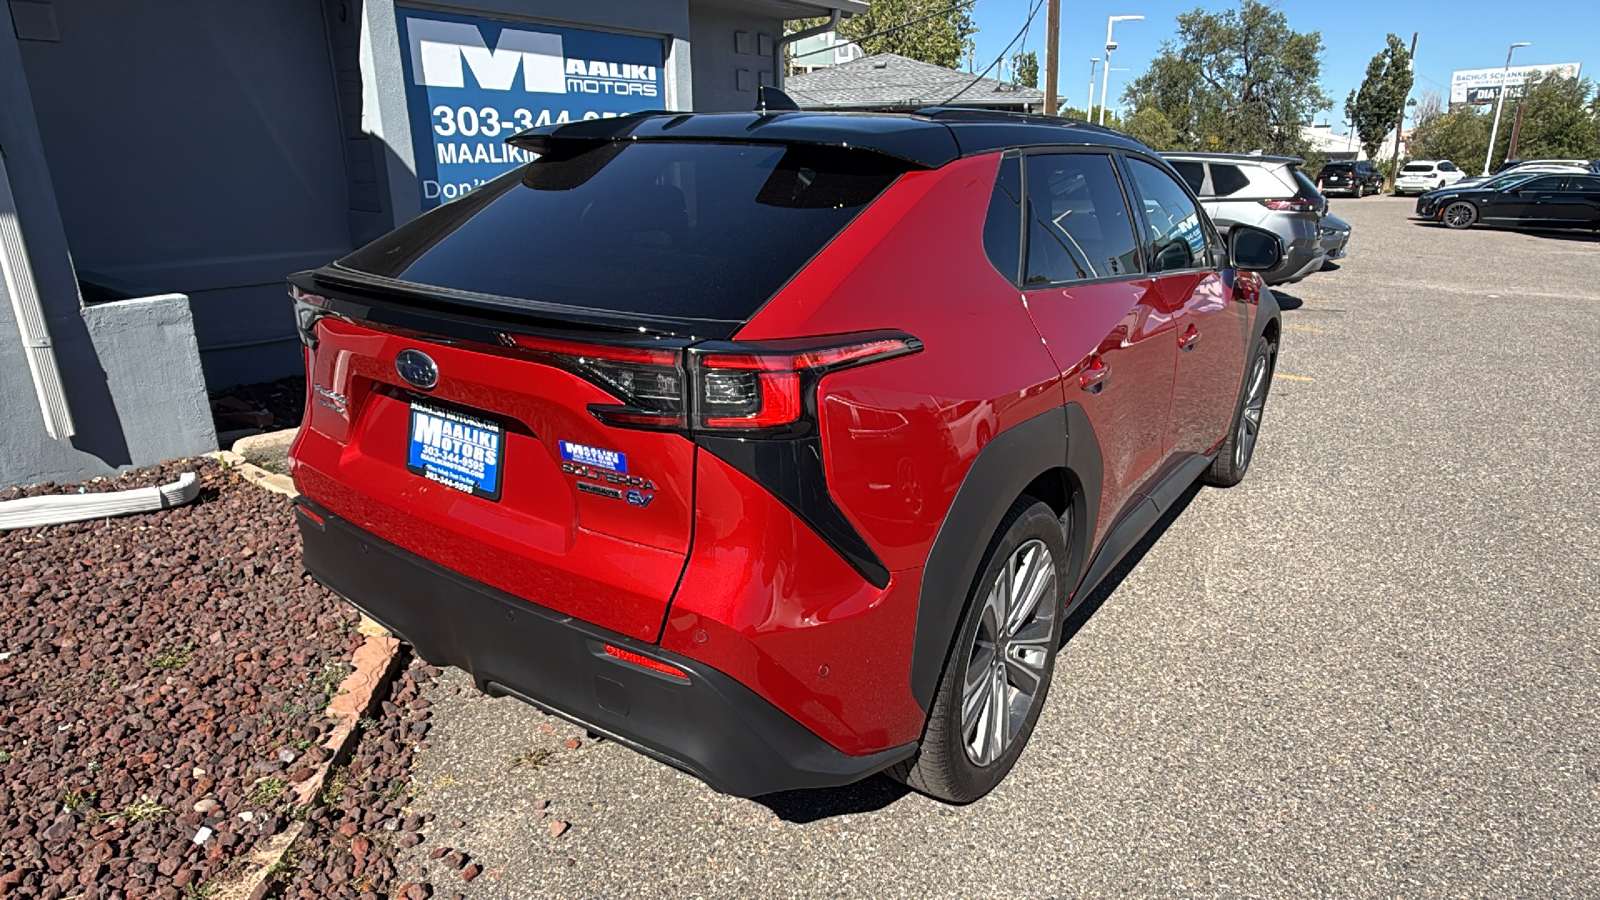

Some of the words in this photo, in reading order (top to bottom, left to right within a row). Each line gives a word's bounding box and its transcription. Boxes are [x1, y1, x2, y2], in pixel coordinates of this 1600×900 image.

[567, 79, 657, 97] MOTORS
[433, 105, 629, 137] 303-34
[423, 178, 487, 199] Don'
[422, 444, 485, 472] 303-344-9595
[562, 462, 659, 492] SOLTERRA
[625, 489, 654, 508] EV
